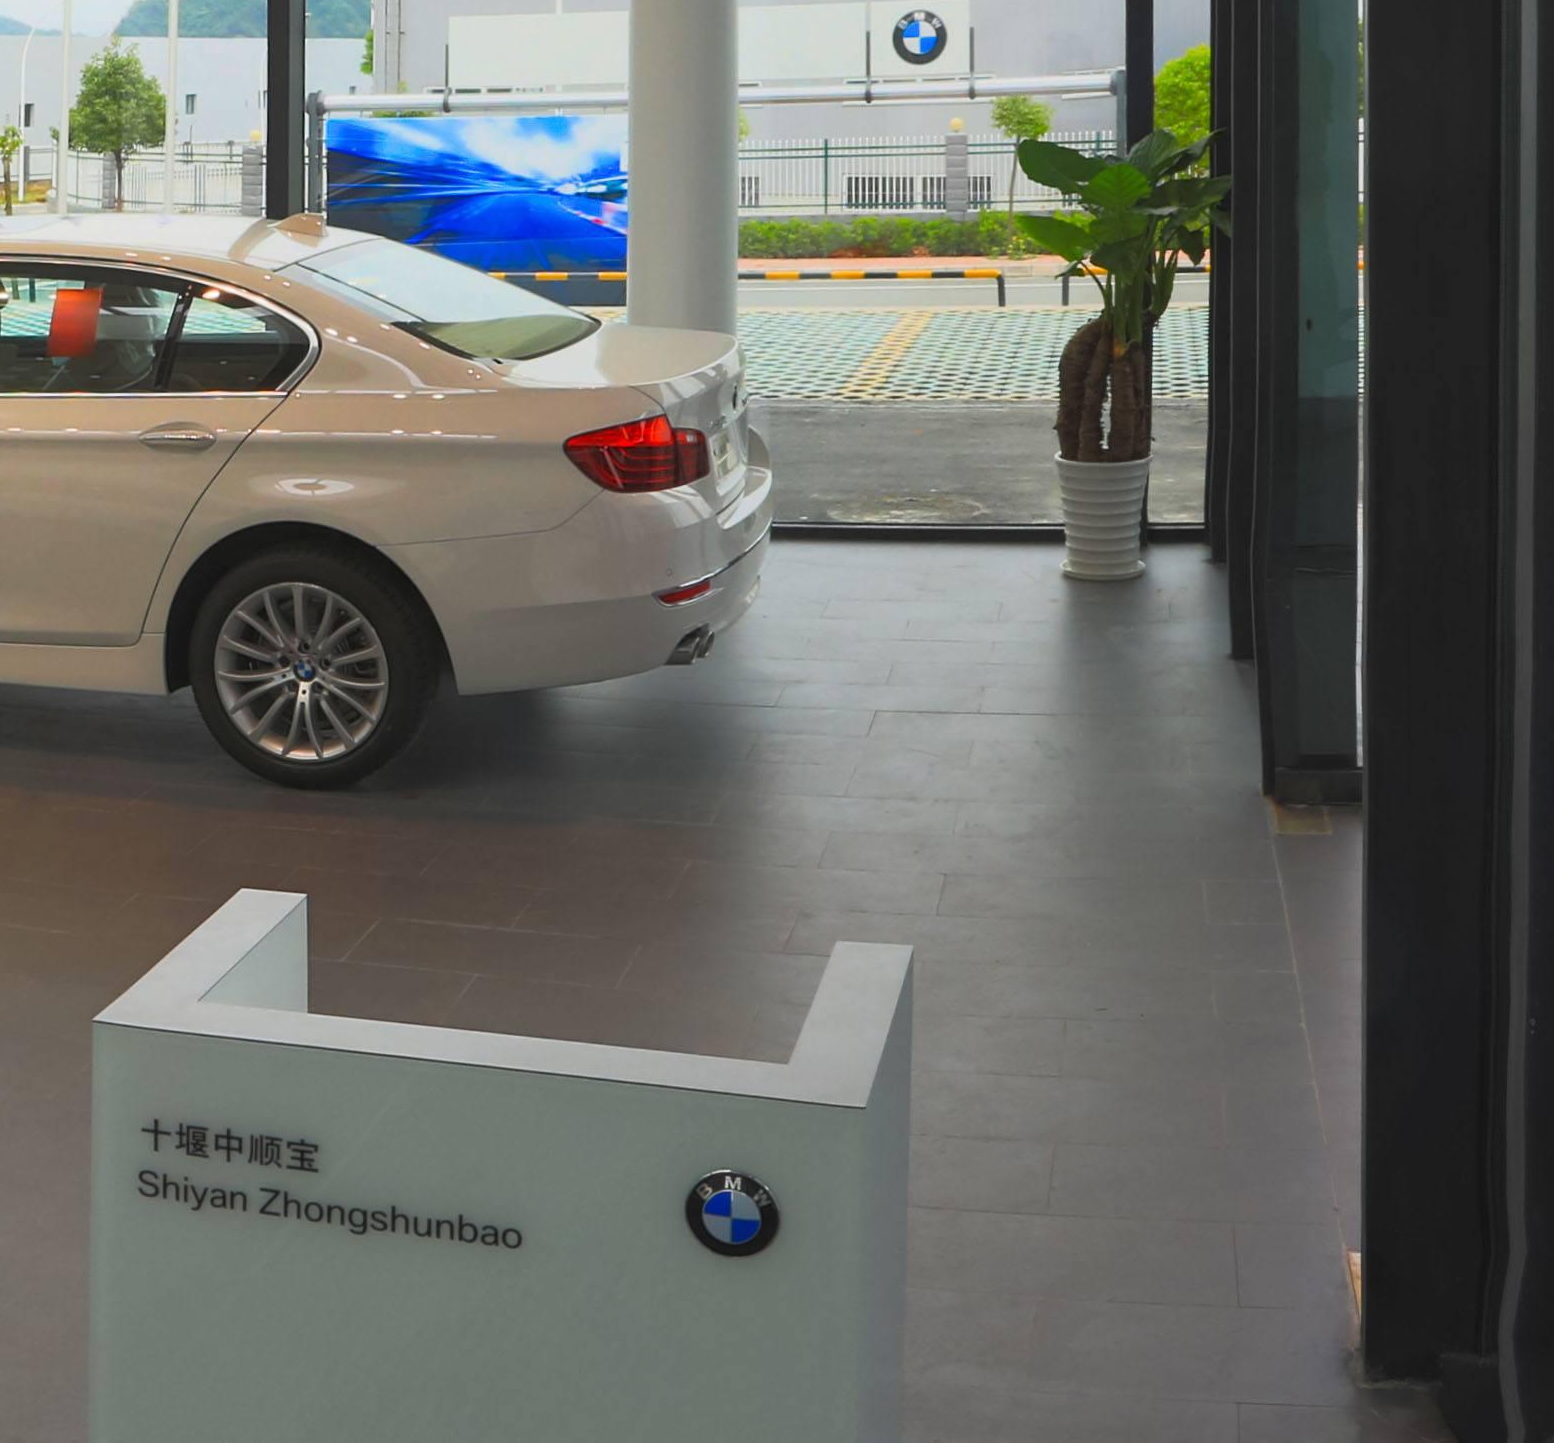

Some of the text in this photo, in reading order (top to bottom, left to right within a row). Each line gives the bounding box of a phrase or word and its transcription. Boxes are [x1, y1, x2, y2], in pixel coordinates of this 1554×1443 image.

[897, 11, 943, 30] BMW
[141, 1118, 320, 1174] 十堰中顺宝
[137, 1169, 523, 1250] Shiyan Zhongshunbao
[696, 1175, 772, 1208] BMW
